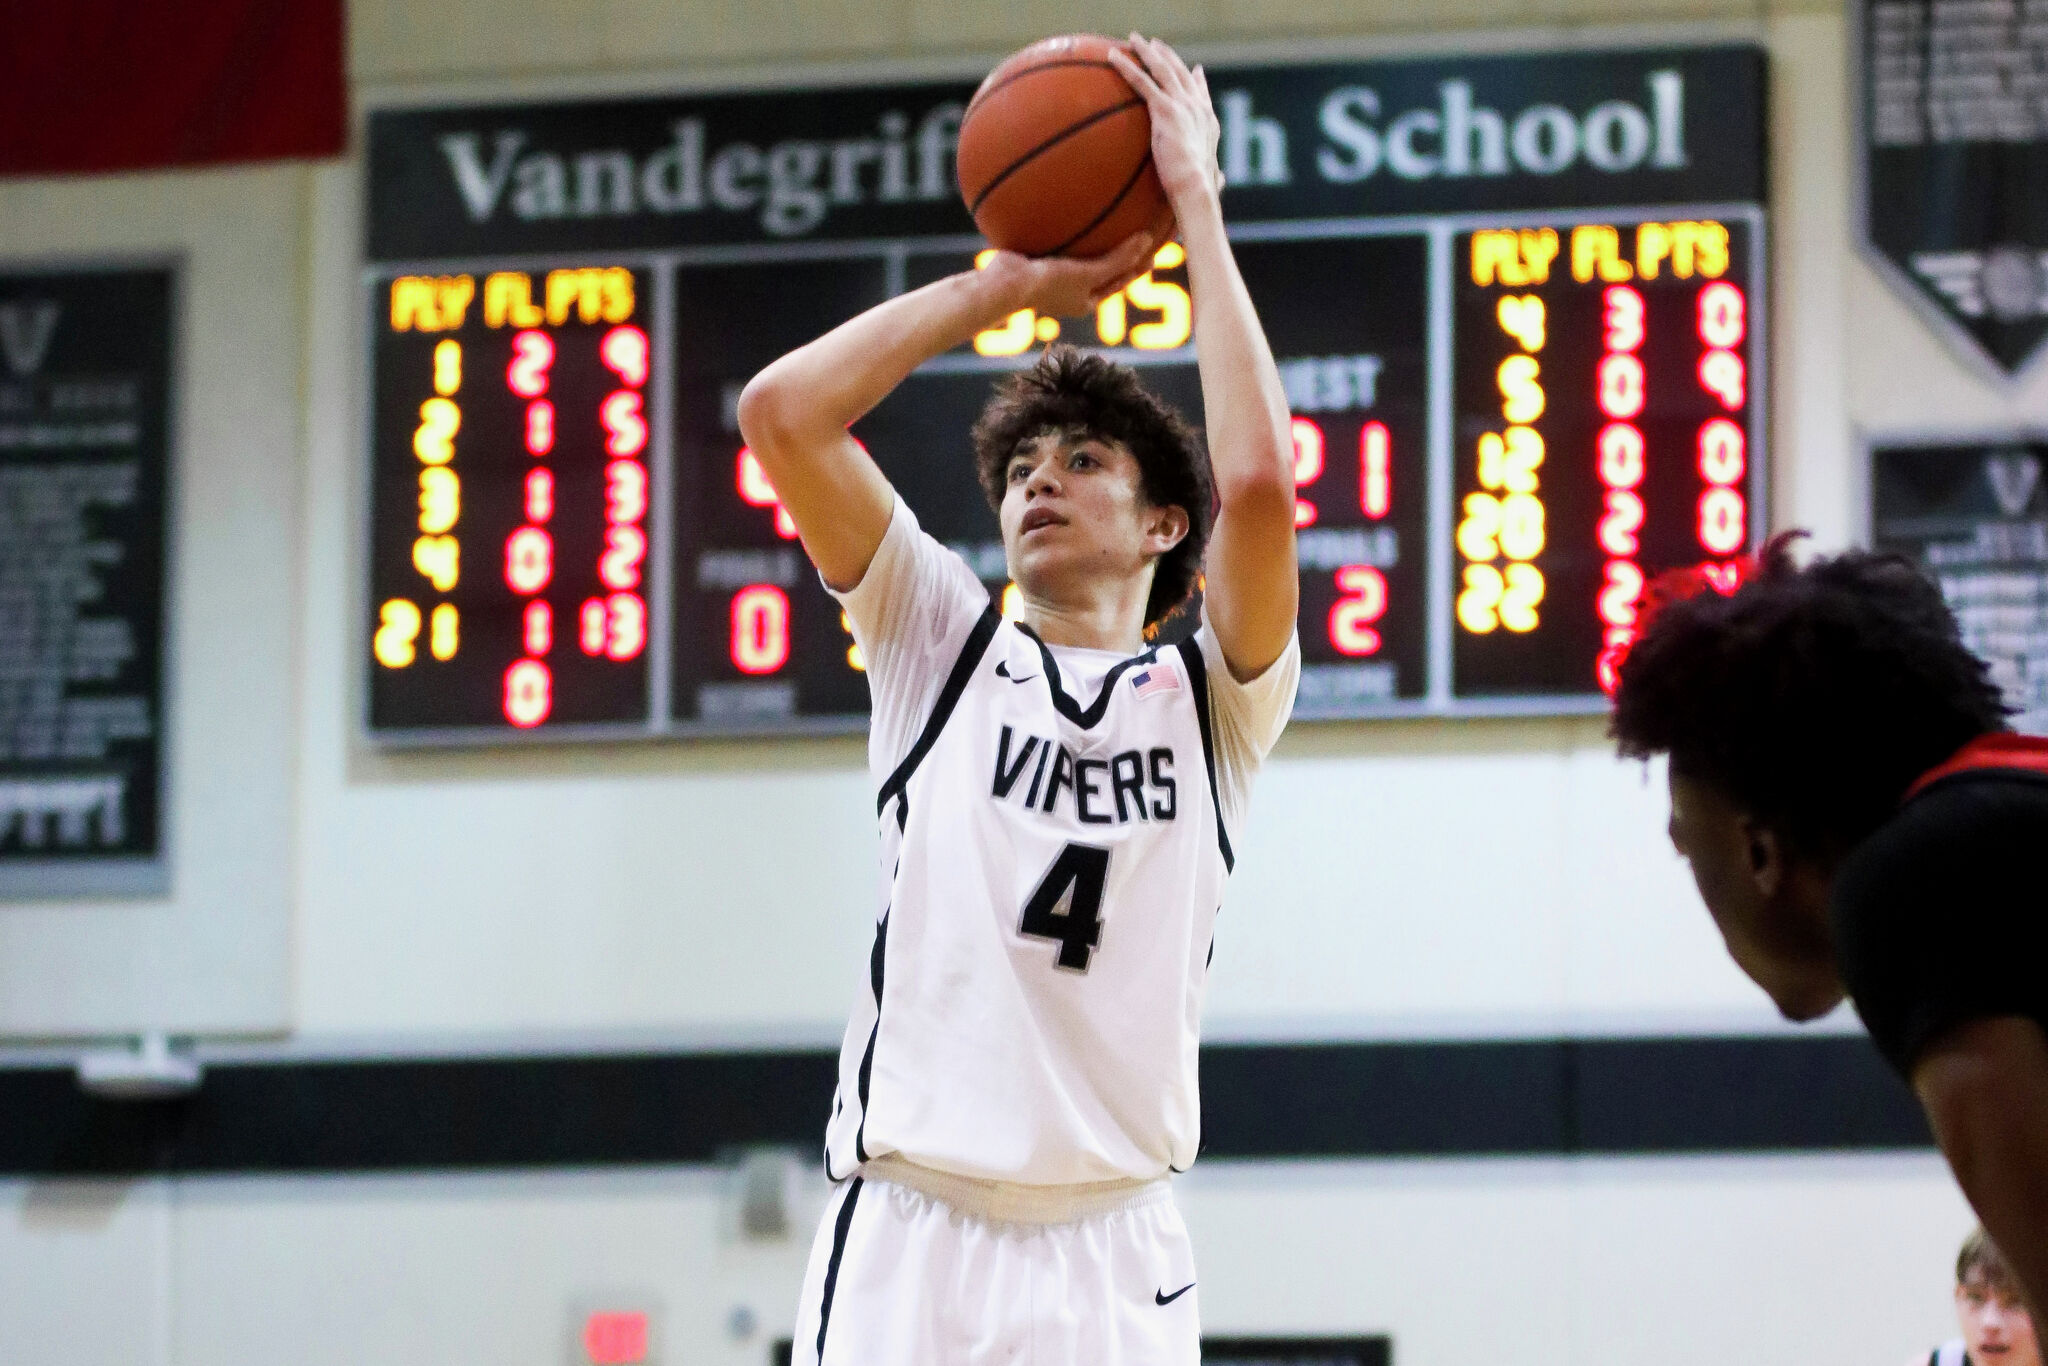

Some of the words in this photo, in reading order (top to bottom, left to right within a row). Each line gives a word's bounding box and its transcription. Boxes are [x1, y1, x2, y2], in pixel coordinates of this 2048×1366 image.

[443, 103, 962, 232] Vandegrif
[1319, 72, 1687, 183] School
[1636, 220, 1730, 280] PTS
[546, 266, 634, 325] PTS
[1496, 294, 1546, 352] 4
[1603, 283, 1645, 353] 3
[1697, 280, 1746, 349] 0
[434, 339, 462, 396] 1
[506, 329, 555, 398] 2
[601, 324, 649, 388] 9
[1496, 354, 1545, 423] 5
[1597, 351, 1645, 419] 0
[1697, 347, 1746, 412] 9
[413, 398, 461, 464] 2
[525, 398, 554, 456] 1
[600, 388, 649, 458] 5
[1478, 425, 1546, 492] 12
[1597, 421, 1646, 489] 0
[1697, 417, 1746, 486] 0
[418, 465, 461, 534] 3
[524, 466, 554, 524] 1
[604, 458, 649, 526] 3
[1457, 491, 1545, 562] 20
[1597, 486, 1646, 557] 2
[1697, 486, 1746, 555] 0
[412, 534, 461, 592] 4
[504, 524, 554, 595] 0
[599, 524, 647, 592] 2
[1457, 561, 1546, 634] 22
[1597, 558, 1646, 626] 2
[374, 598, 459, 668] 21
[524, 598, 552, 657] 1
[579, 592, 647, 662] 13
[731, 584, 790, 674] 0
[1328, 564, 1388, 656] 2
[503, 657, 552, 728] 0
[991, 724, 1177, 824] VIPERS
[1016, 839, 1113, 975] 4
